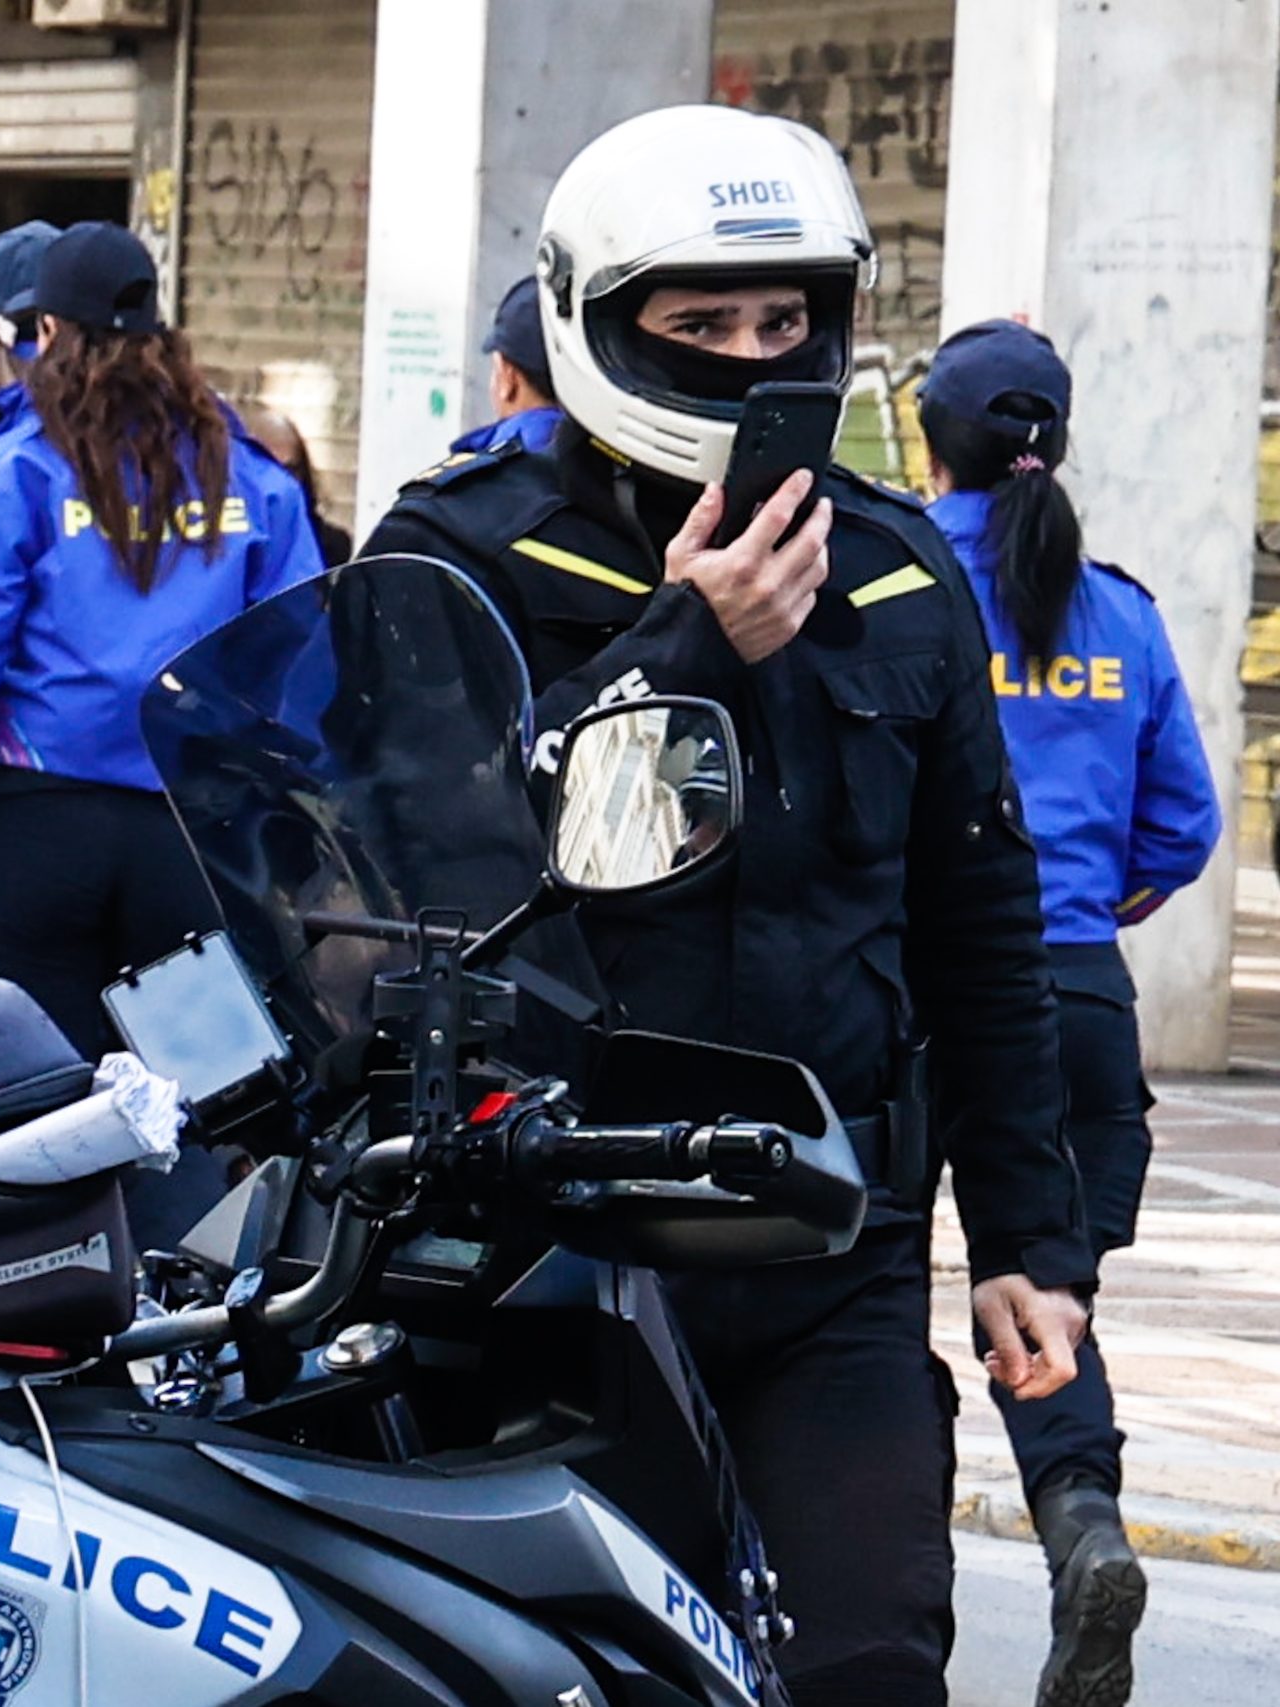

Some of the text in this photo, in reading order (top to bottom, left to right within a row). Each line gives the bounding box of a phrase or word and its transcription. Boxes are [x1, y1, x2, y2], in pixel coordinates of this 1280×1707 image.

[708, 180, 796, 208] SHOEI
[990, 652, 1124, 699] LICE
[664, 1570, 762, 1700] POLIC
